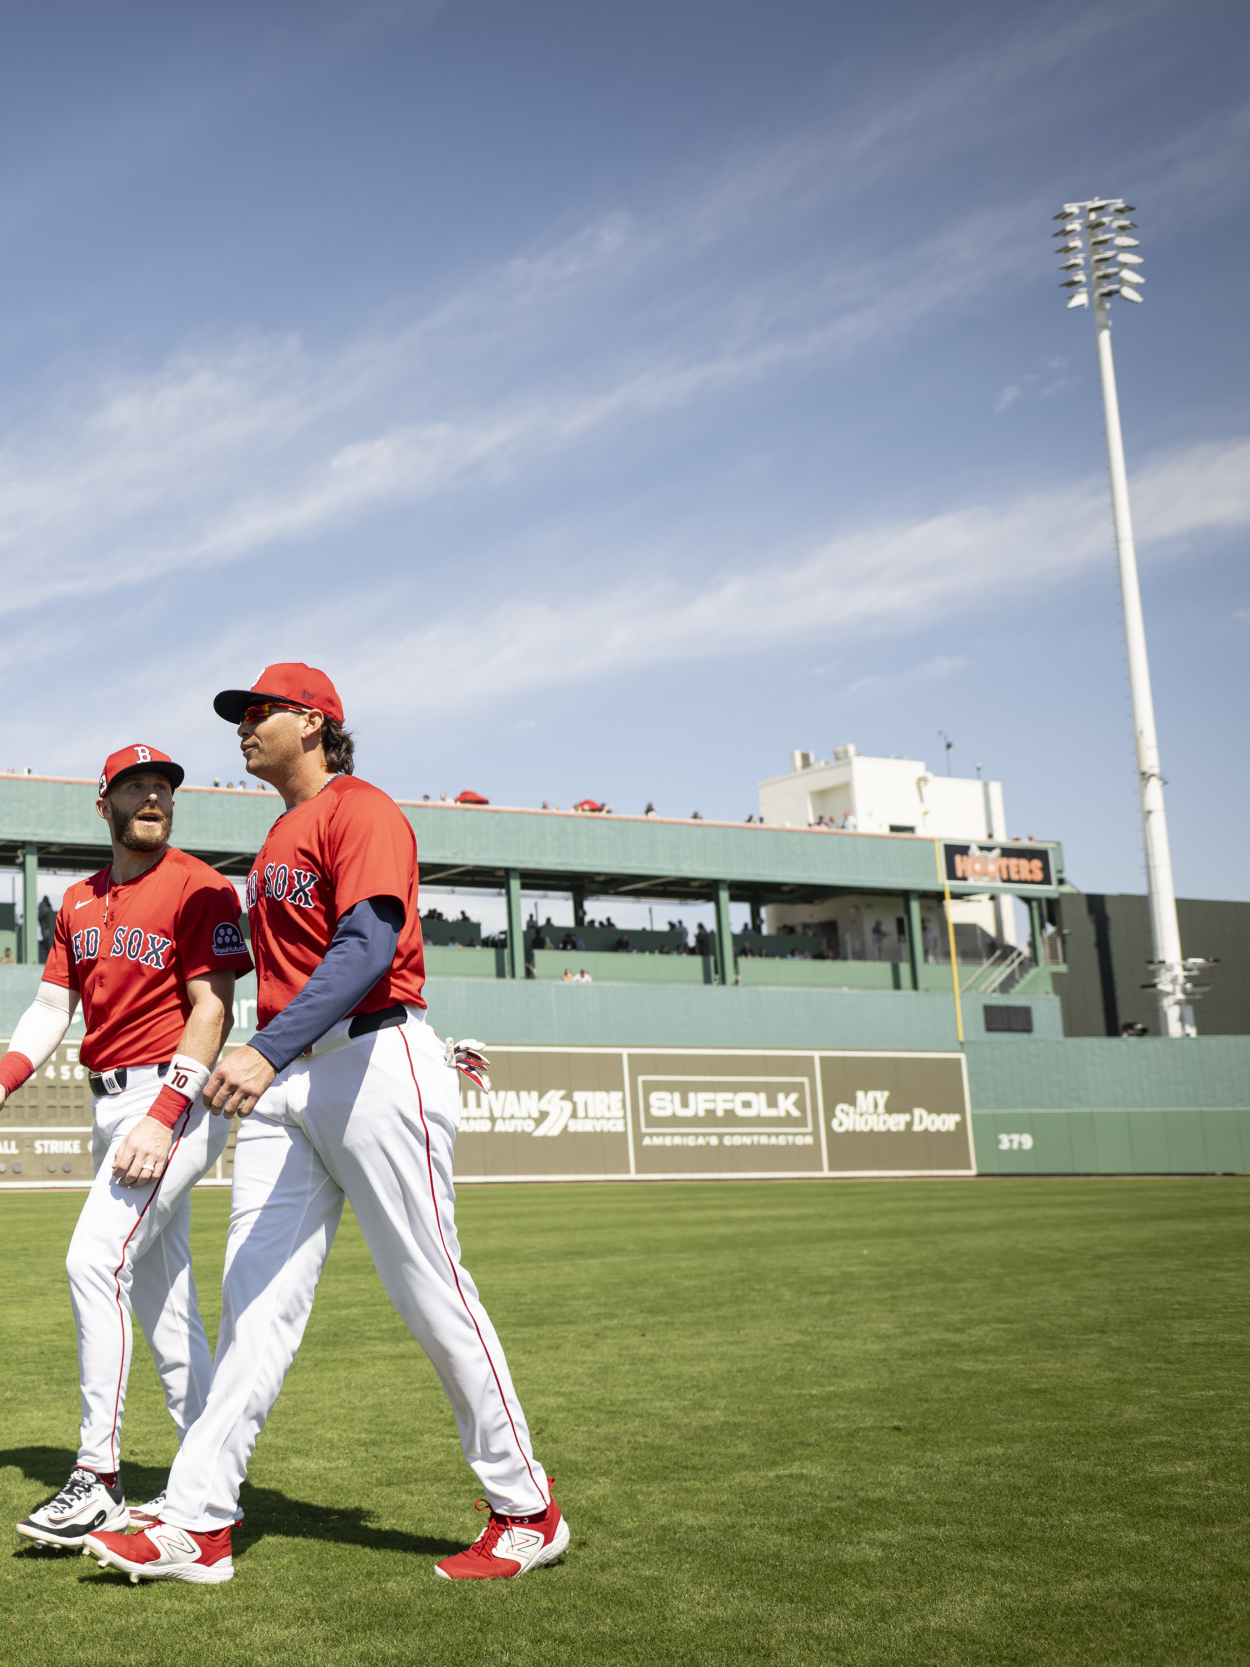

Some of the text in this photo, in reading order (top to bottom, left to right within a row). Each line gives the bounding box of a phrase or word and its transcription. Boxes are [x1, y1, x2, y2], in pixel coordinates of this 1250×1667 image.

[133, 746, 152, 764] B
[954, 854, 1044, 882] HOOTERS
[264, 861, 319, 909] SOX
[110, 925, 172, 970] SOX
[171, 1071, 188, 1089] 10
[573, 1090, 625, 1118] TIRE
[649, 1091, 801, 1117] SUFFOLK
[855, 1090, 890, 1114] MY
[493, 1119, 536, 1132] AUTO
[567, 1119, 625, 1132] SERVICE
[831, 1103, 961, 1132] Shower Door
[34, 1139, 81, 1155] STRIKE
[642, 1135, 814, 1146] AMERICA'S CONTRACTOR
[997, 1133, 1034, 1150] 379
